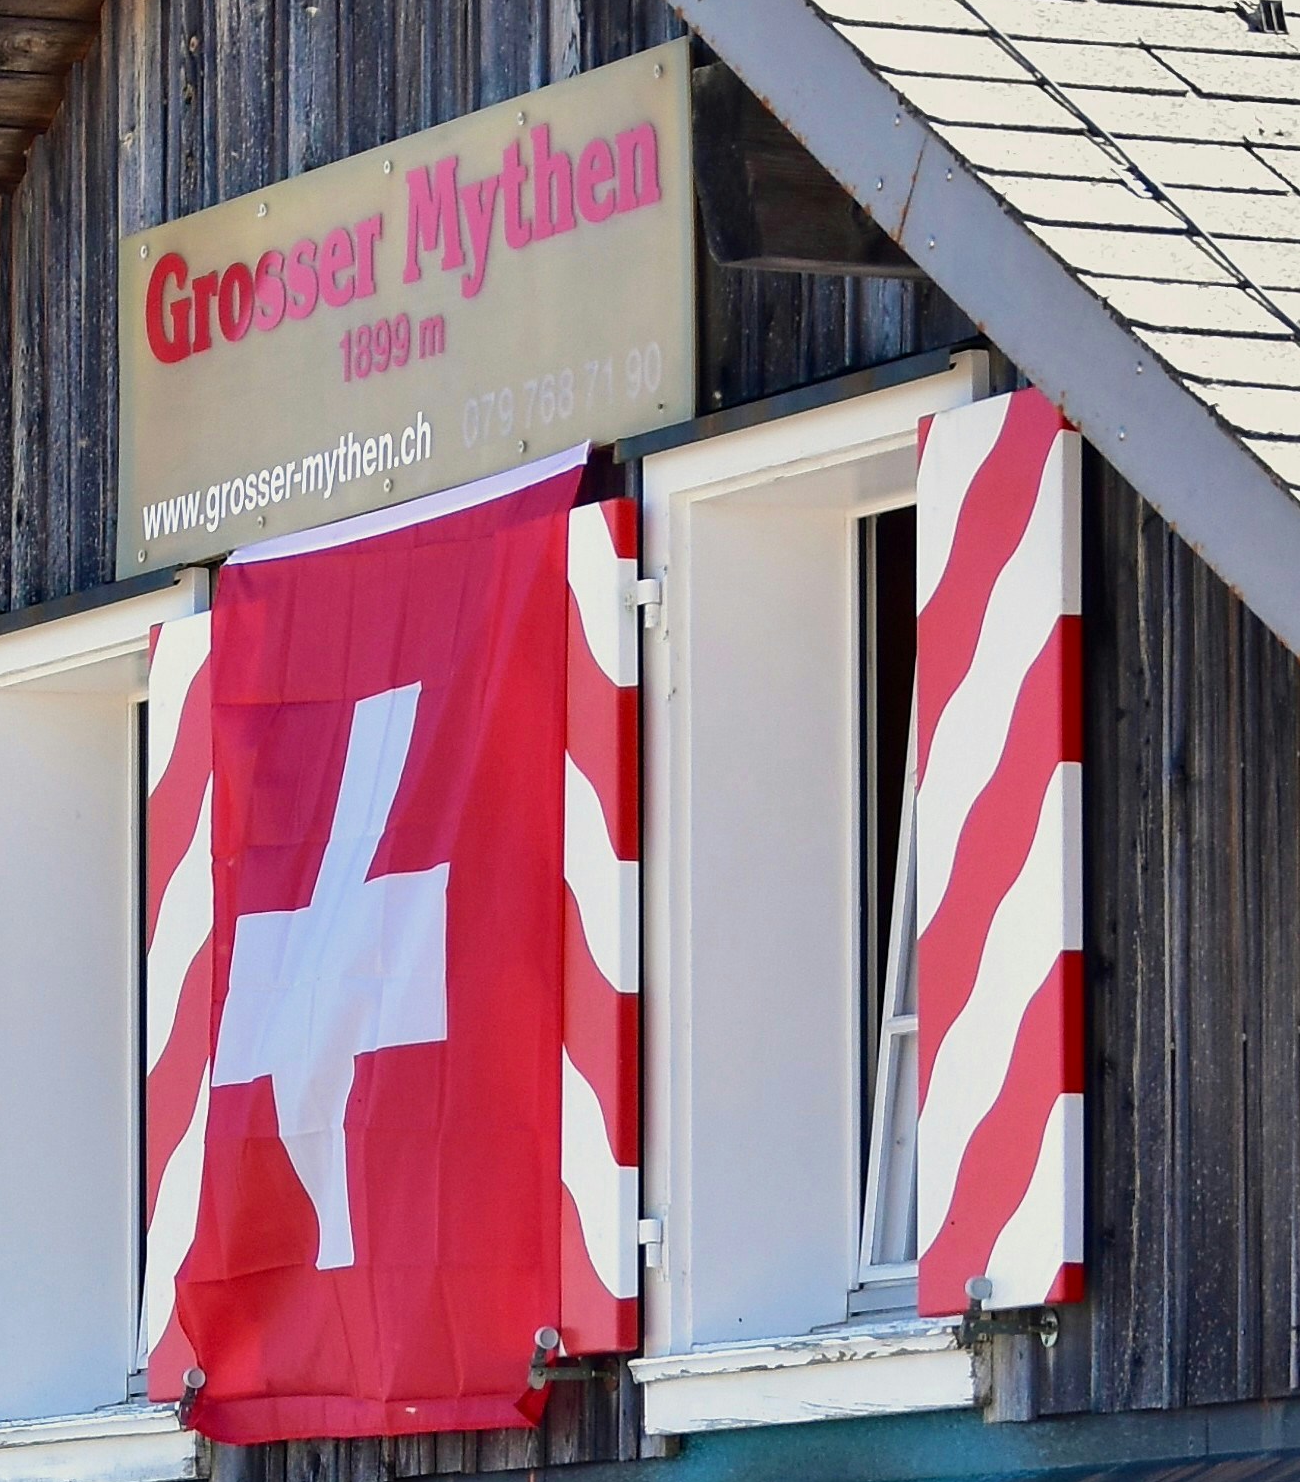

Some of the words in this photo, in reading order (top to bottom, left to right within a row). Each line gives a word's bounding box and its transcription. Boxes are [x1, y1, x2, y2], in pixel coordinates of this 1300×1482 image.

[145, 216, 384, 365] Grosser
[403, 122, 663, 300] Mythen
[339, 316, 411, 383] 1899
[418, 315, 446, 361] m
[462, 395, 515, 451] 079
[523, 372, 575, 427] 768
[582, 361, 614, 412] 71
[624, 341, 663, 395] 90
[142, 411, 433, 541] www.grosser-mythen.ch
